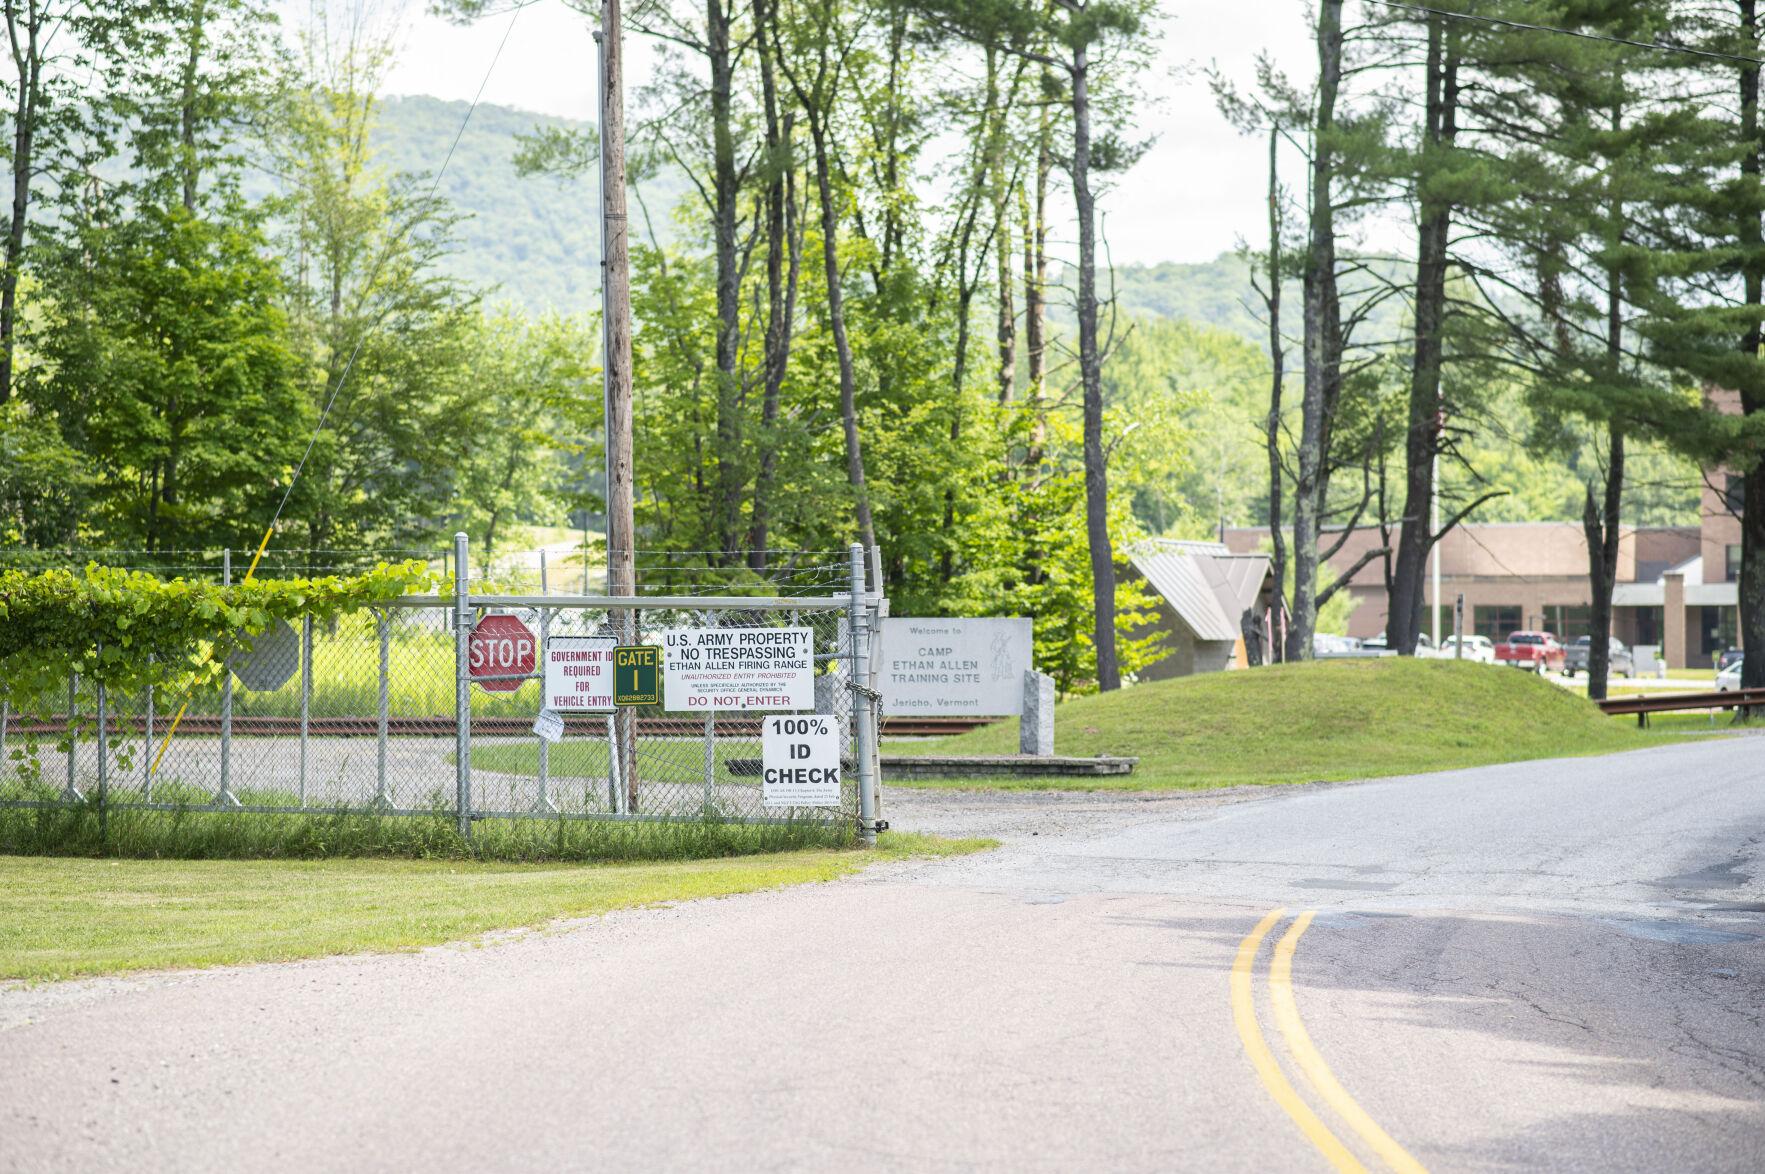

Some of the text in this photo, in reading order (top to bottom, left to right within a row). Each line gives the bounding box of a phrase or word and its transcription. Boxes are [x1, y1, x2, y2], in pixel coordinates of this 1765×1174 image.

[909, 627, 962, 635] Welcome to
[667, 632, 809, 647] U.S. ARMY PROPERTY
[470, 639, 531, 668] STOP
[551, 651, 613, 662] GOVERNMENT ID
[681, 646, 796, 660] NO TRESPASSING
[918, 647, 953, 657] CAMP
[618, 651, 654, 666] GATE
[669, 660, 808, 671] ETHAN ALLEN FIRING RANGE
[893, 660, 978, 670] ETHAN ALLEN
[563, 665, 601, 678] REQUIRED
[891, 673, 981, 683] TRAINING SITE
[575, 681, 590, 692] FOR
[553, 695, 612, 707] VEHICLE ENTRY
[688, 695, 791, 706] DO NOT ENTER
[892, 698, 979, 708] Jericho, Vermont
[772, 719, 828, 735] 100%
[790, 744, 811, 759] ID
[764, 768, 839, 784] CHECK
